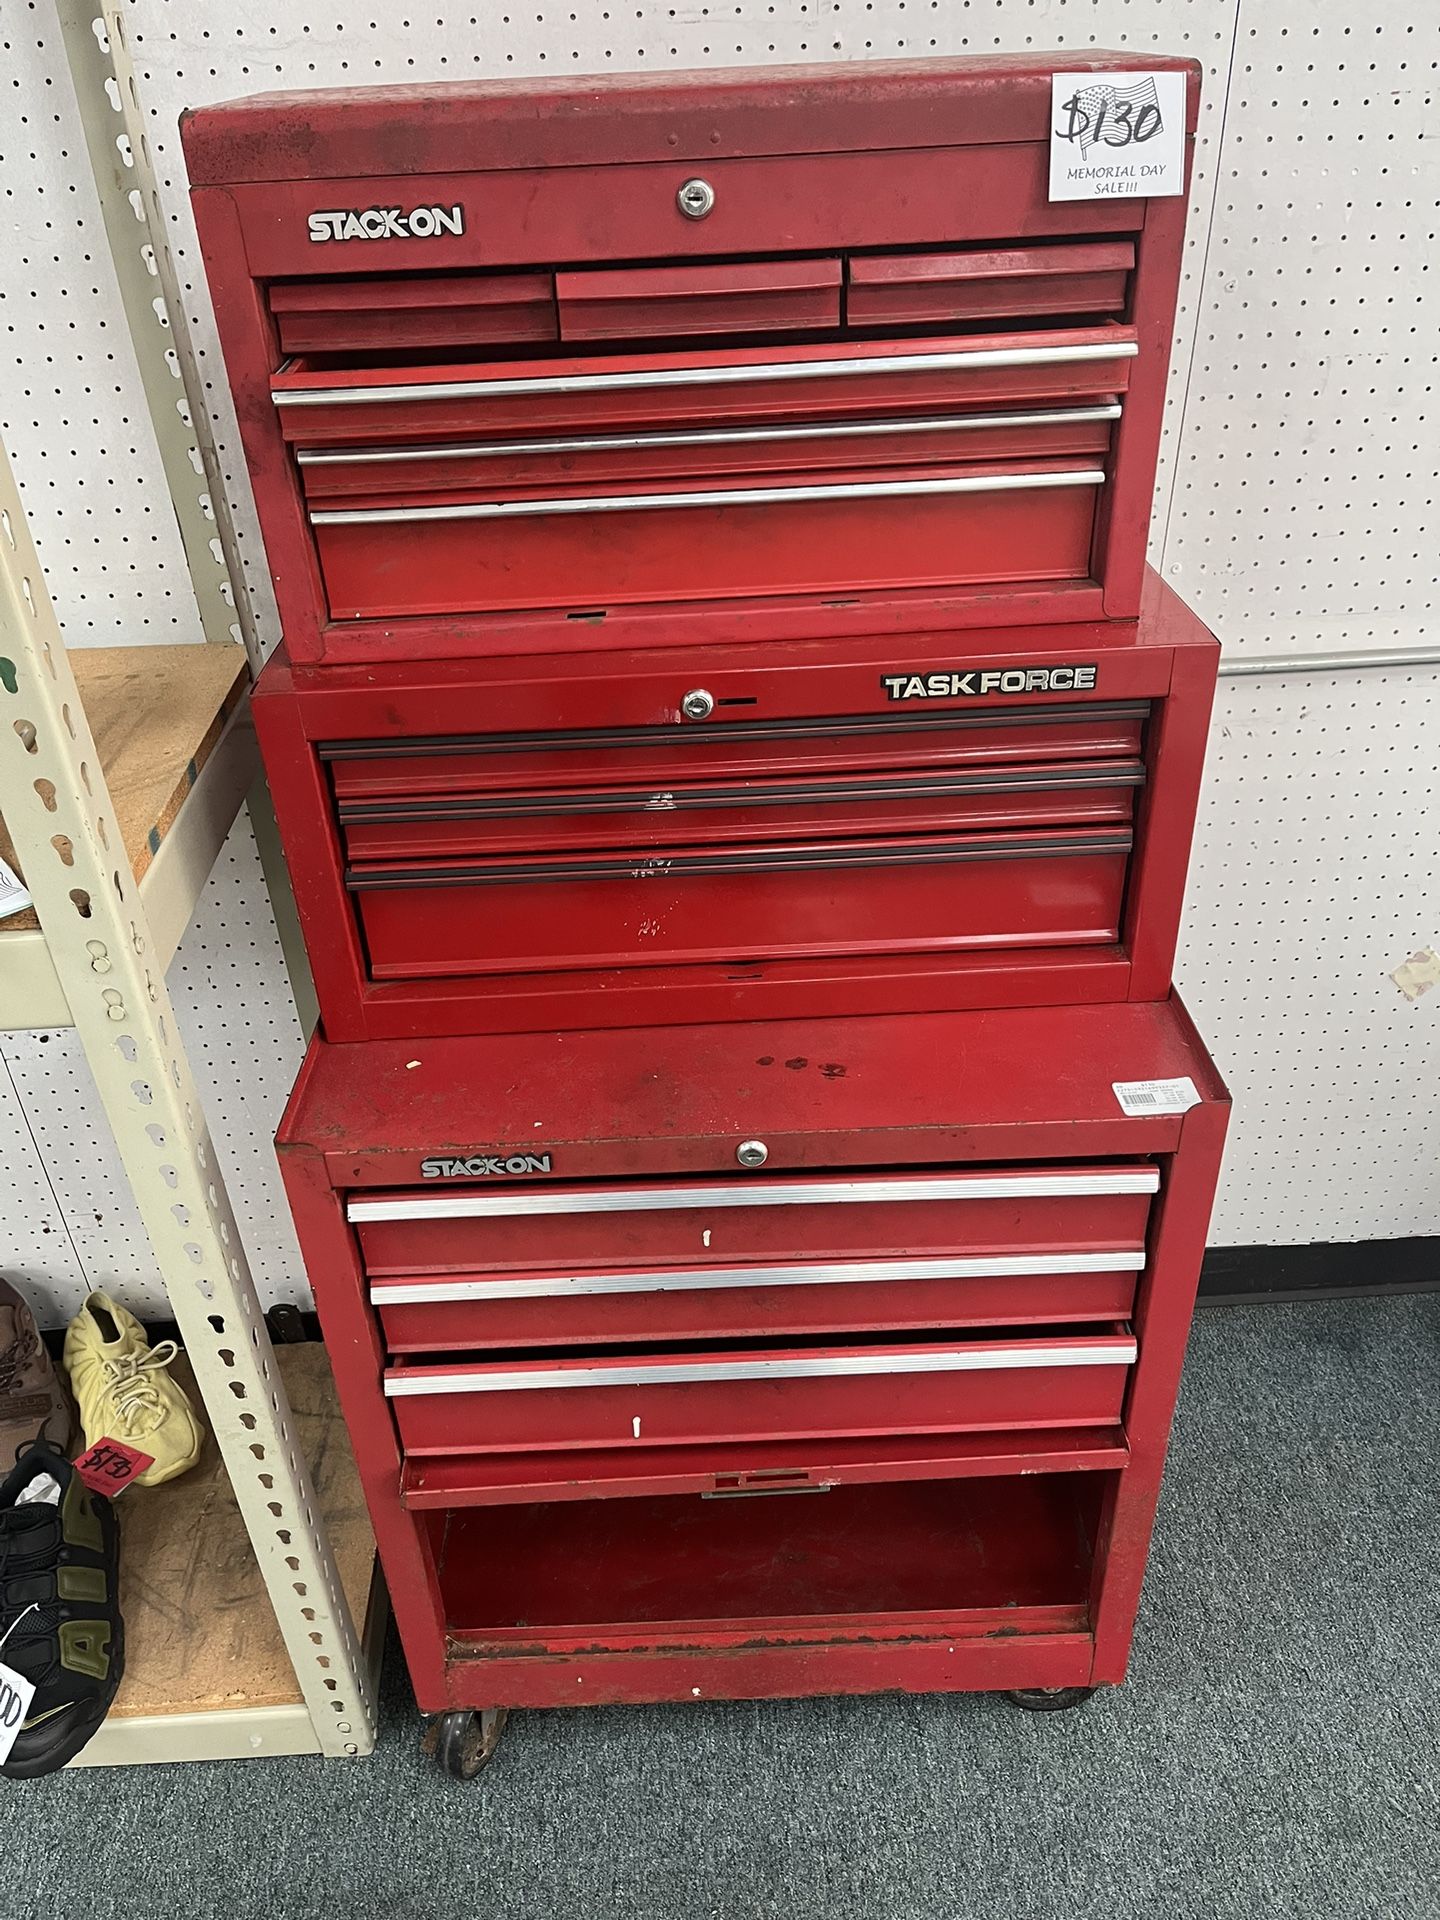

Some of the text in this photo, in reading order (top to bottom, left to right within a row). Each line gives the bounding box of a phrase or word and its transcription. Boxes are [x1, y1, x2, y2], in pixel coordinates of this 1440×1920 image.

[1055, 94, 1162, 147] $130
[1066, 164, 1167, 181] MEMORIAL DAY
[1094, 182, 1138, 195] SALE!!!
[307, 206, 464, 242] STACK-ON
[885, 667, 1096, 699] TASK FORCE
[421, 1155, 551, 1178] STACK-ON
[0, 1678, 22, 1728] 00
